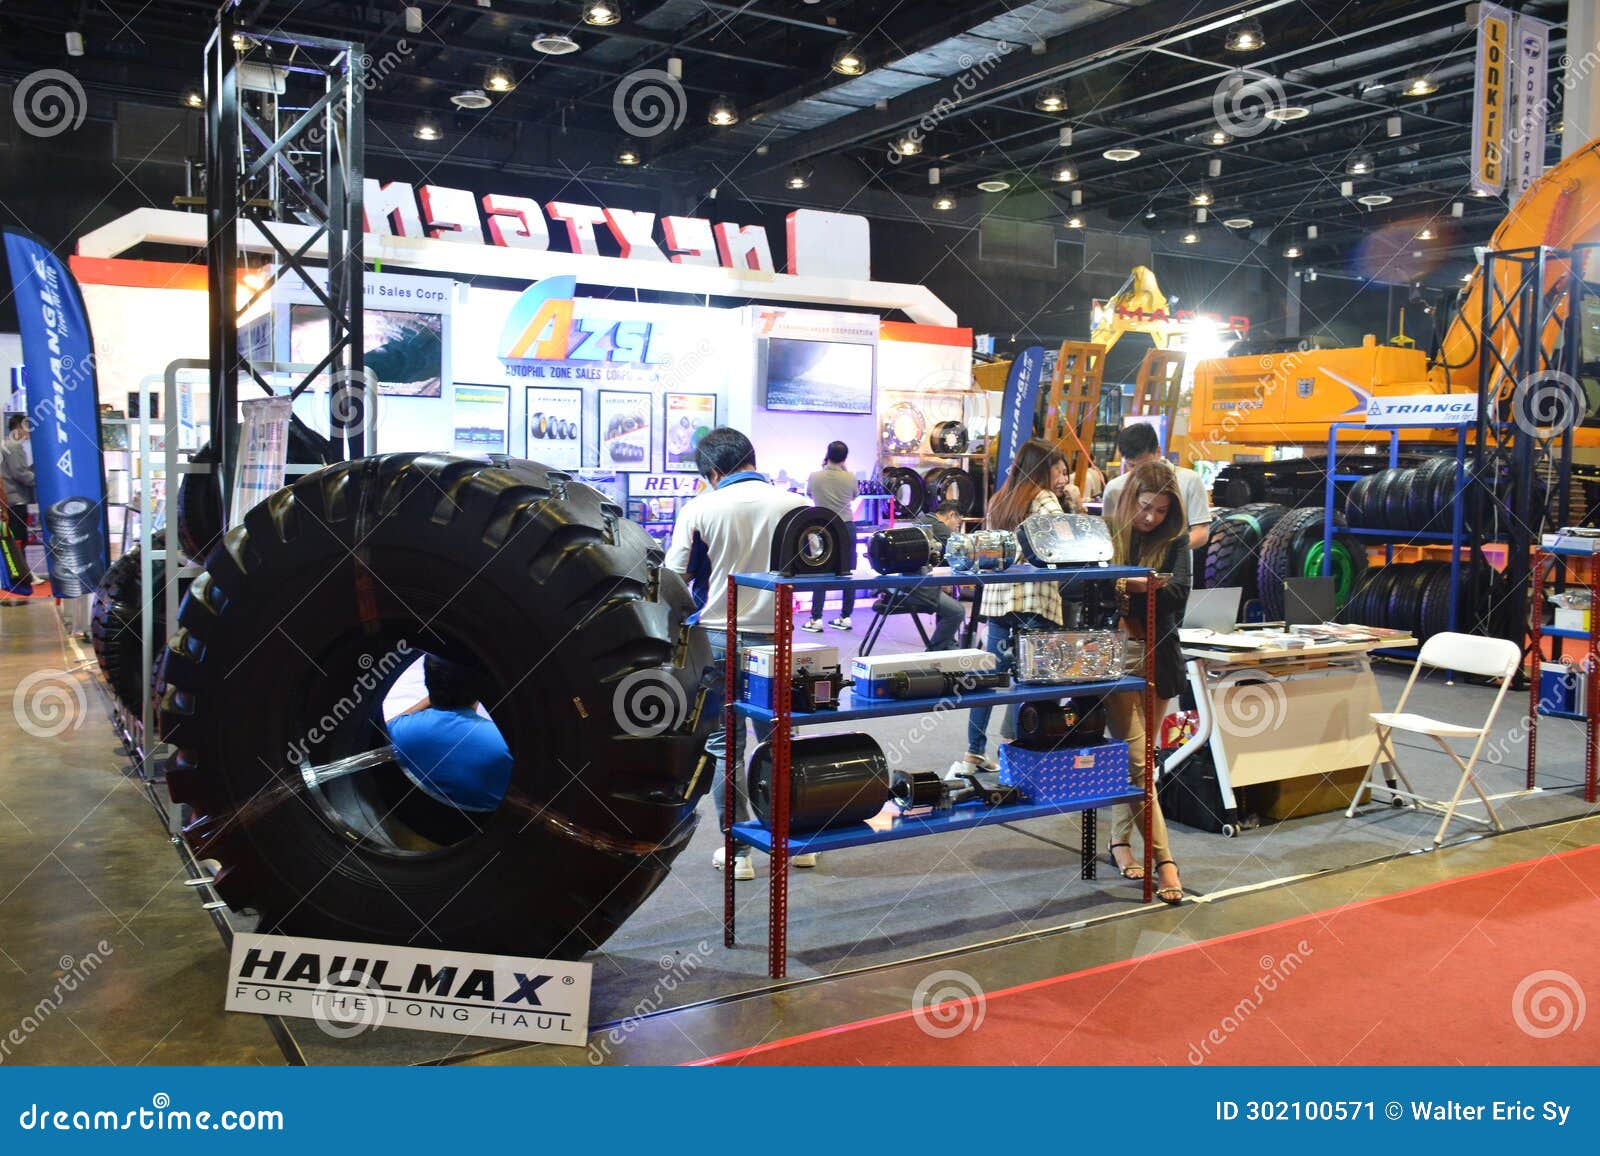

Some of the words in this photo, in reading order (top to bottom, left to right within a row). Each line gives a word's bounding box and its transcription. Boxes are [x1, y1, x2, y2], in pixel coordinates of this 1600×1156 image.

[379, 286, 411, 298] Sales
[416, 289, 448, 301] Corp.
[32, 254, 68, 443] TRIANGLE
[505, 364, 546, 378] AUTOPHIL
[550, 366, 572, 379] ZONE
[575, 368, 600, 380] SALES
[1386, 403, 1475, 414] TRIANGL
[238, 948, 554, 1007] HAULMAX
[234, 986, 294, 1004] FOR
[312, 993, 368, 1012] THE
[388, 1001, 470, 1022] LONG
[490, 1012, 574, 1032] HAUL
